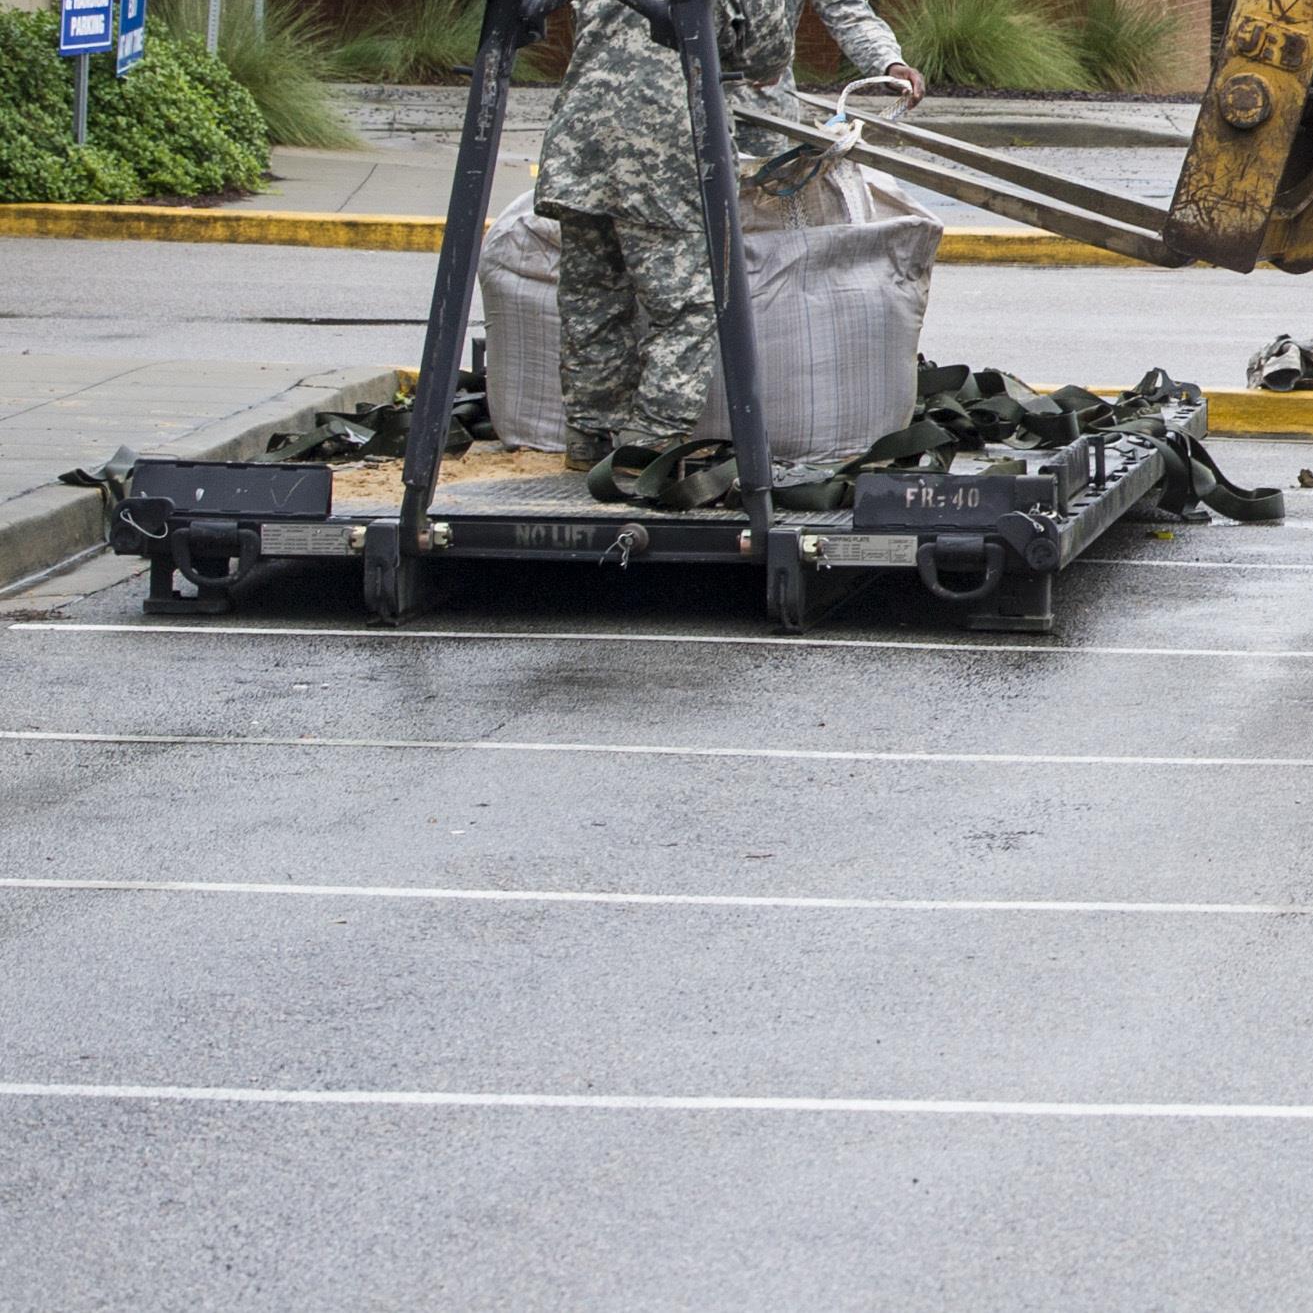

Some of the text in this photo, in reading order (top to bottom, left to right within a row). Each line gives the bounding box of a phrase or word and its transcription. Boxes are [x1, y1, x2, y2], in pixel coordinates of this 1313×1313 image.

[70, 14, 105, 37] PARKING
[516, 524, 598, 548] NO LIFT
